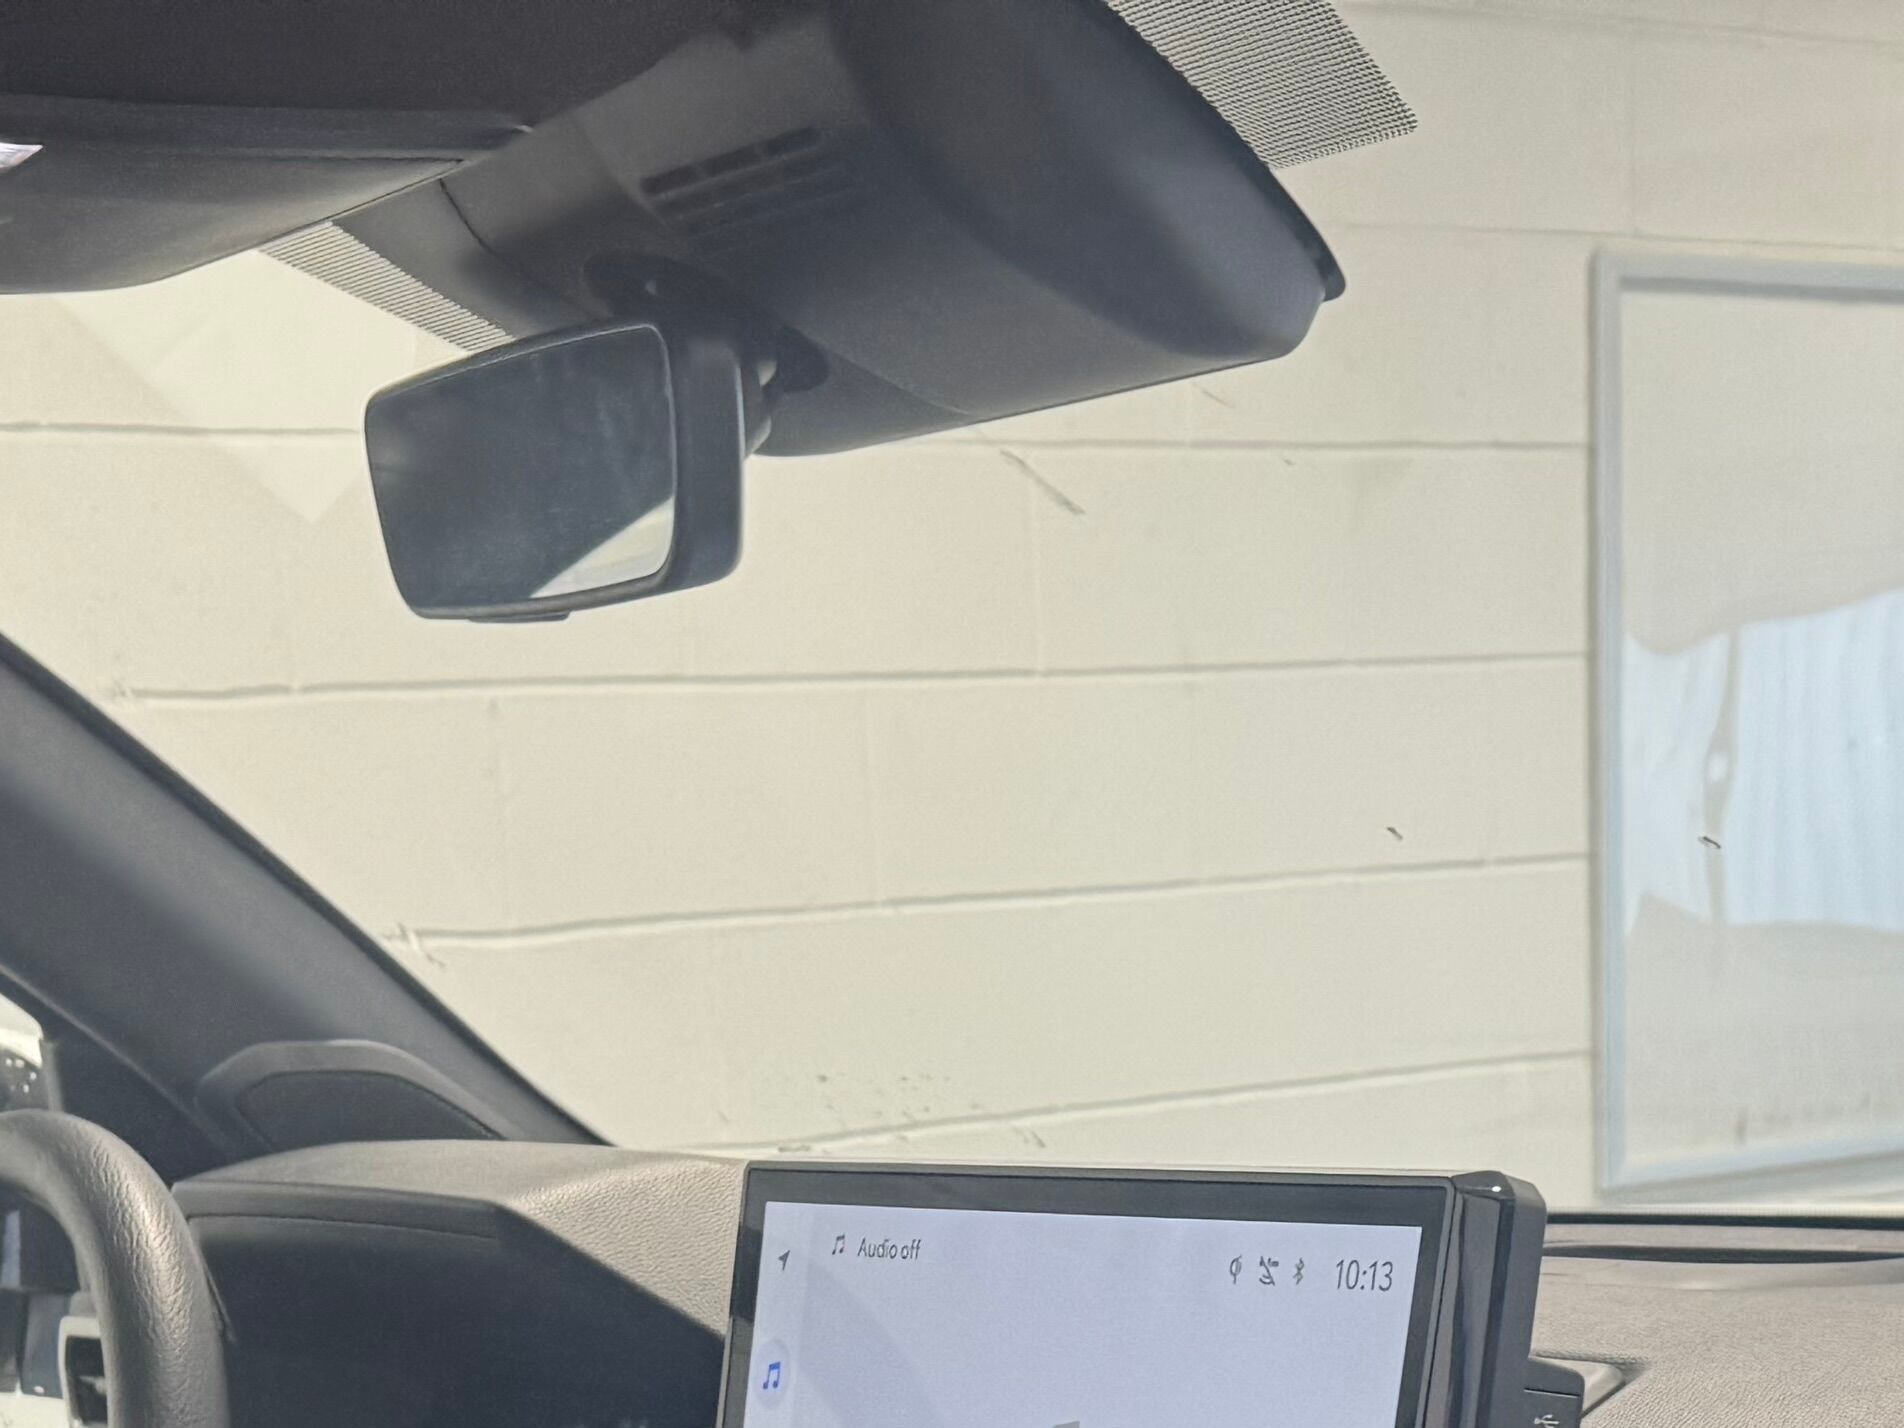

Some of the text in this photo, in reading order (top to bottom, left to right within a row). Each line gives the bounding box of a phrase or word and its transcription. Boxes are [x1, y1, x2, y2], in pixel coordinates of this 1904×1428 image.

[857, 1237, 922, 1261] Audio off
[1335, 1258, 1394, 1292] 10:13
